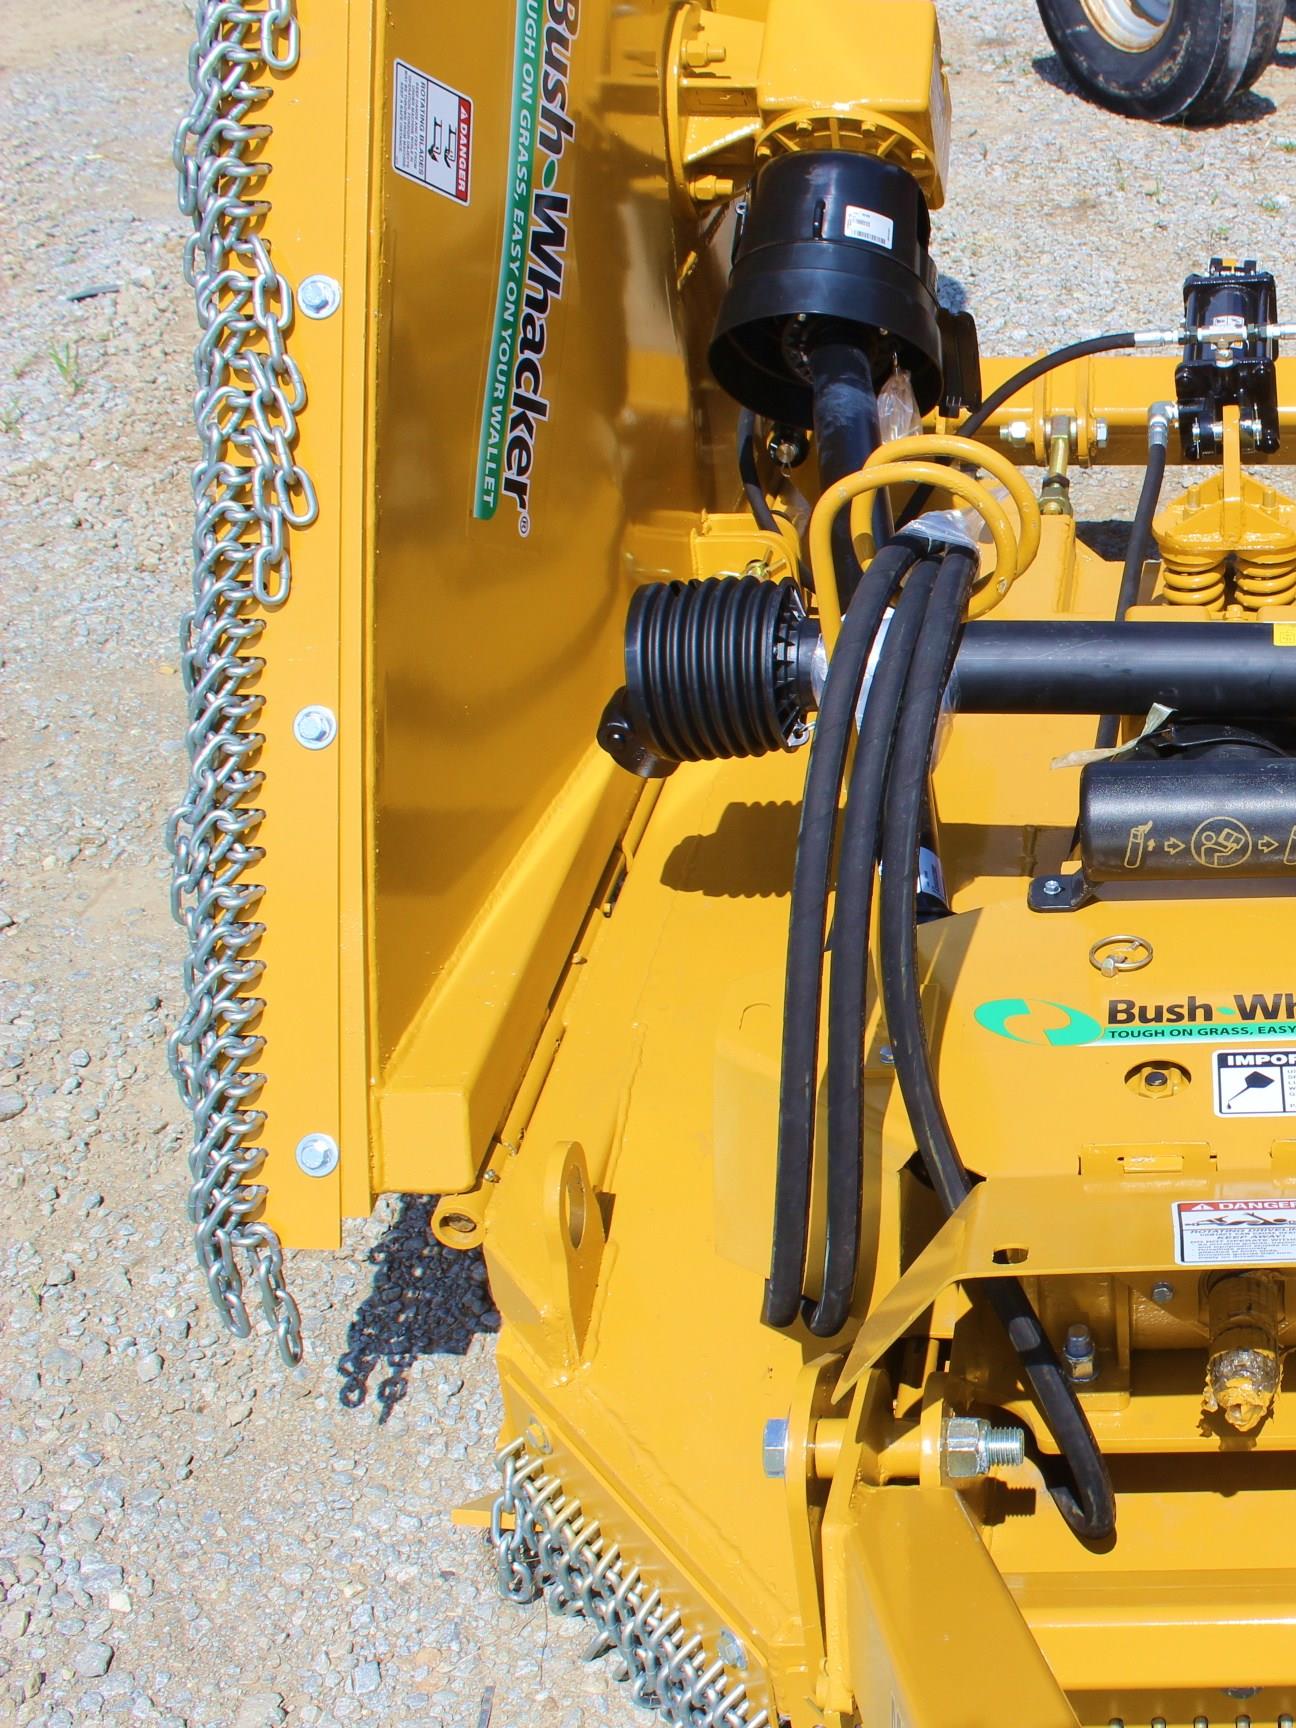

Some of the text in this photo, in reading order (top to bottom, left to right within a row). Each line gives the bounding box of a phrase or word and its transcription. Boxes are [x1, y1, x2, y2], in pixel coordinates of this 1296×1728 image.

[520, 63, 533, 105] ON
[538, 0, 580, 159] Bush
[458, 122, 468, 192] DANGER
[514, 108, 531, 202] GRASS,
[508, 209, 525, 275] EASY
[504, 282, 518, 324] ON
[493, 330, 513, 400] YOUR
[482, 406, 504, 508] WALLET
[1108, 996, 1213, 1025] Bush
[1109, 1029, 1165, 1039] TOUGH
[1169, 1028, 1194, 1037] ON
[1199, 1026, 1254, 1036] GRASS,
[1257, 1025, 1296, 1034] EASY
